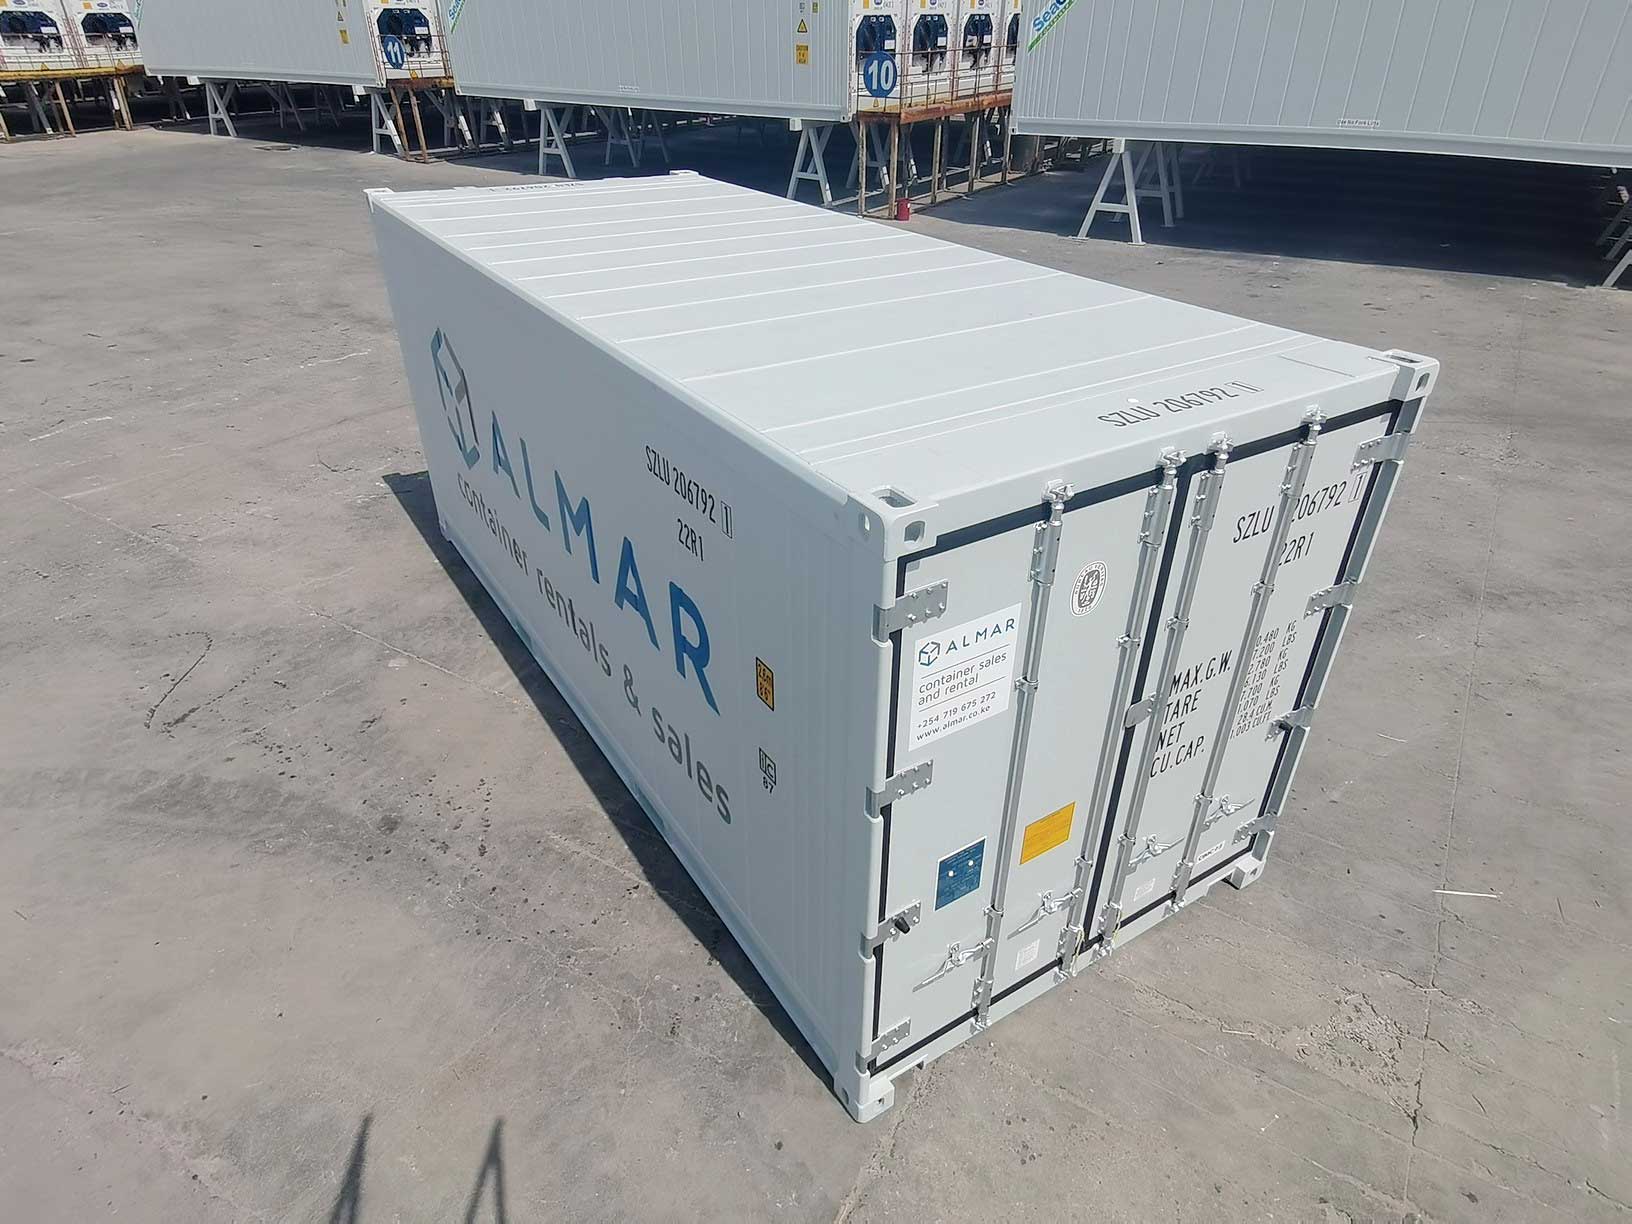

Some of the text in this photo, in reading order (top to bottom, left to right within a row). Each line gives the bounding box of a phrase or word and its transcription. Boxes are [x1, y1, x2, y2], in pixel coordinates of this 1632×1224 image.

[387, 41, 403, 64] 11
[868, 59, 894, 90] 10
[1097, 406, 1161, 427] SZLU
[1152, 387, 1240, 413] 206792
[645, 444, 670, 486] SZLU
[672, 466, 716, 524] 206792
[677, 518, 704, 562] 22R1
[1232, 505, 1275, 543] SZLU
[491, 410, 721, 717] ALMAR
[945, 618, 1015, 655] ALMAR
[1282, 631, 1297, 647] LBS
[1285, 619, 1297, 634] KG
[457, 472, 732, 825] container rentals & sales
[1273, 658, 1288, 674] LBS
[1278, 647, 1288, 661] KG
[917, 672, 979, 706] and rental
[918, 652, 1007, 694] container sales
[916, 704, 991, 741] www.almar.co.ke
[917, 691, 996, 729] +254 719 675 272
[1164, 689, 1202, 725] TARE
[1155, 721, 1185, 753] NET
[1150, 735, 1204, 778] CU.CAP.
